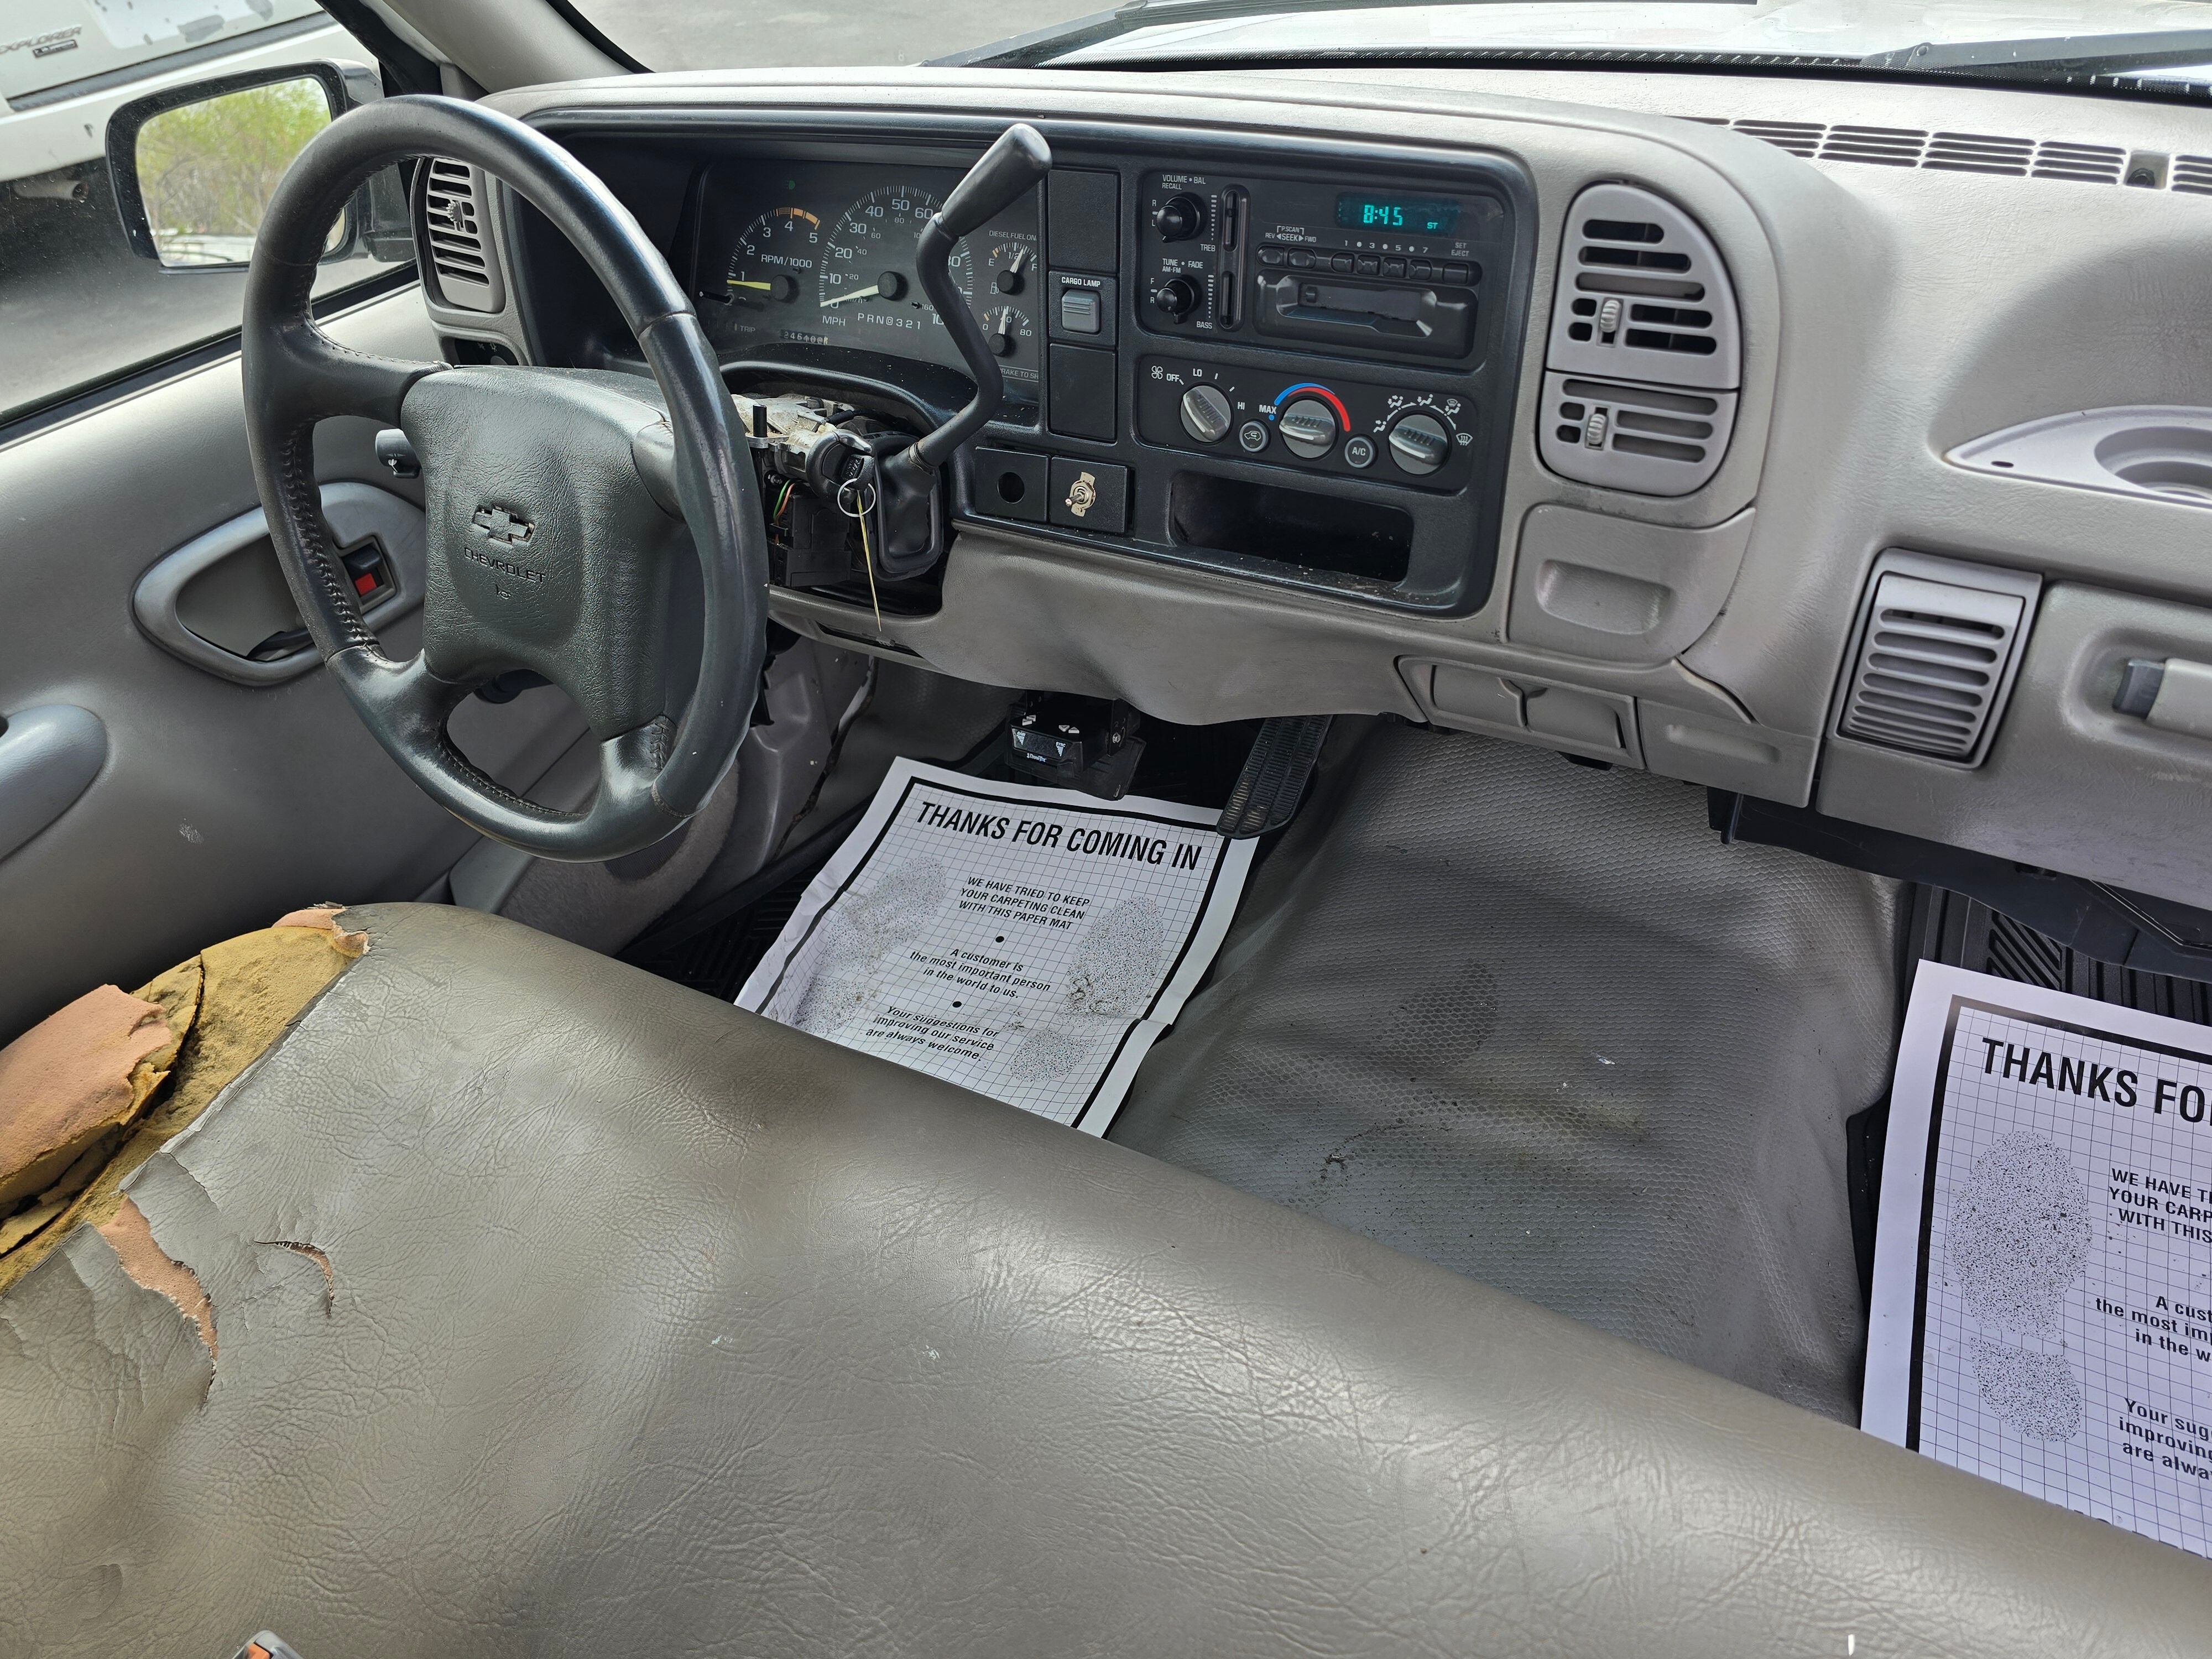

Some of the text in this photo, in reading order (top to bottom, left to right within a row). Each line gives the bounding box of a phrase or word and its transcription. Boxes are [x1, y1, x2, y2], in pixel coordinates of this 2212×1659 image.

[0, 25, 82, 54] XPLORER
[1162, 174, 1206, 185] VOLUME BAL
[865, 205, 884, 217] 40
[891, 199, 910, 211] 50
[915, 207, 933, 219] 60
[1363, 205, 1403, 226] 8:45
[763, 227, 771, 238] 3
[784, 221, 794, 232] 4
[849, 222, 867, 234] 30
[809, 232, 818, 243] 5
[989, 230, 1010, 238] DIESEL
[1282, 233, 1298, 242] SEEK
[747, 244, 755, 255] 2
[835, 247, 852, 259] 20
[988, 258, 995, 267] E
[1162, 258, 1203, 269] TUNE FADE
[741, 270, 745, 281] 1
[829, 273, 841, 285] 10
[1062, 276, 1100, 288] CARGO LAMP
[822, 315, 846, 326] MPH
[1196, 321, 1213, 329] BASS
[1000, 368, 1018, 377] RAKE
[1166, 373, 1180, 383] OFF
[1193, 368, 1202, 377] LO
[1238, 402, 1245, 410] HI
[1259, 404, 1277, 414] MAX
[1352, 447, 1366, 456] A/C
[464, 547, 546, 583] CHEVROLET
[917, 801, 1202, 870] THANKS FOR COMING IN
[968, 877, 1090, 907] WE HAVE TRIED TO KEEP
[961, 888, 1085, 920] YOUR CARPETING CLEAN
[959, 900, 1074, 930] WITH THIS PAPER MAT
[961, 952, 1011, 969] customer
[1013, 962, 1024, 972] is
[910, 951, 1051, 992] the most important person
[923, 967, 1019, 998] in the world to us.
[886, 1006, 1000, 1037] Your suggestions for
[873, 1014, 995, 1051] improving our service
[865, 1029, 982, 1061] are always welcome.
[1983, 1037, 2212, 1126] THANKS FO
[2111, 1168, 2139, 1186] WE
[2145, 1176, 2191, 1199] HAVE
[2109, 1186, 2212, 1223] YOUR CARP
[2119, 1208, 2212, 1244] WITH THIS
[2156, 1296, 2212, 1323] A cust
[2095, 1298, 2212, 1346] the most im
[2136, 1328, 2152, 1345] in
[2159, 1336, 2189, 1355] the
[2124, 1397, 2212, 1442] Your sug
[2122, 1442, 2212, 1480] are alwa
